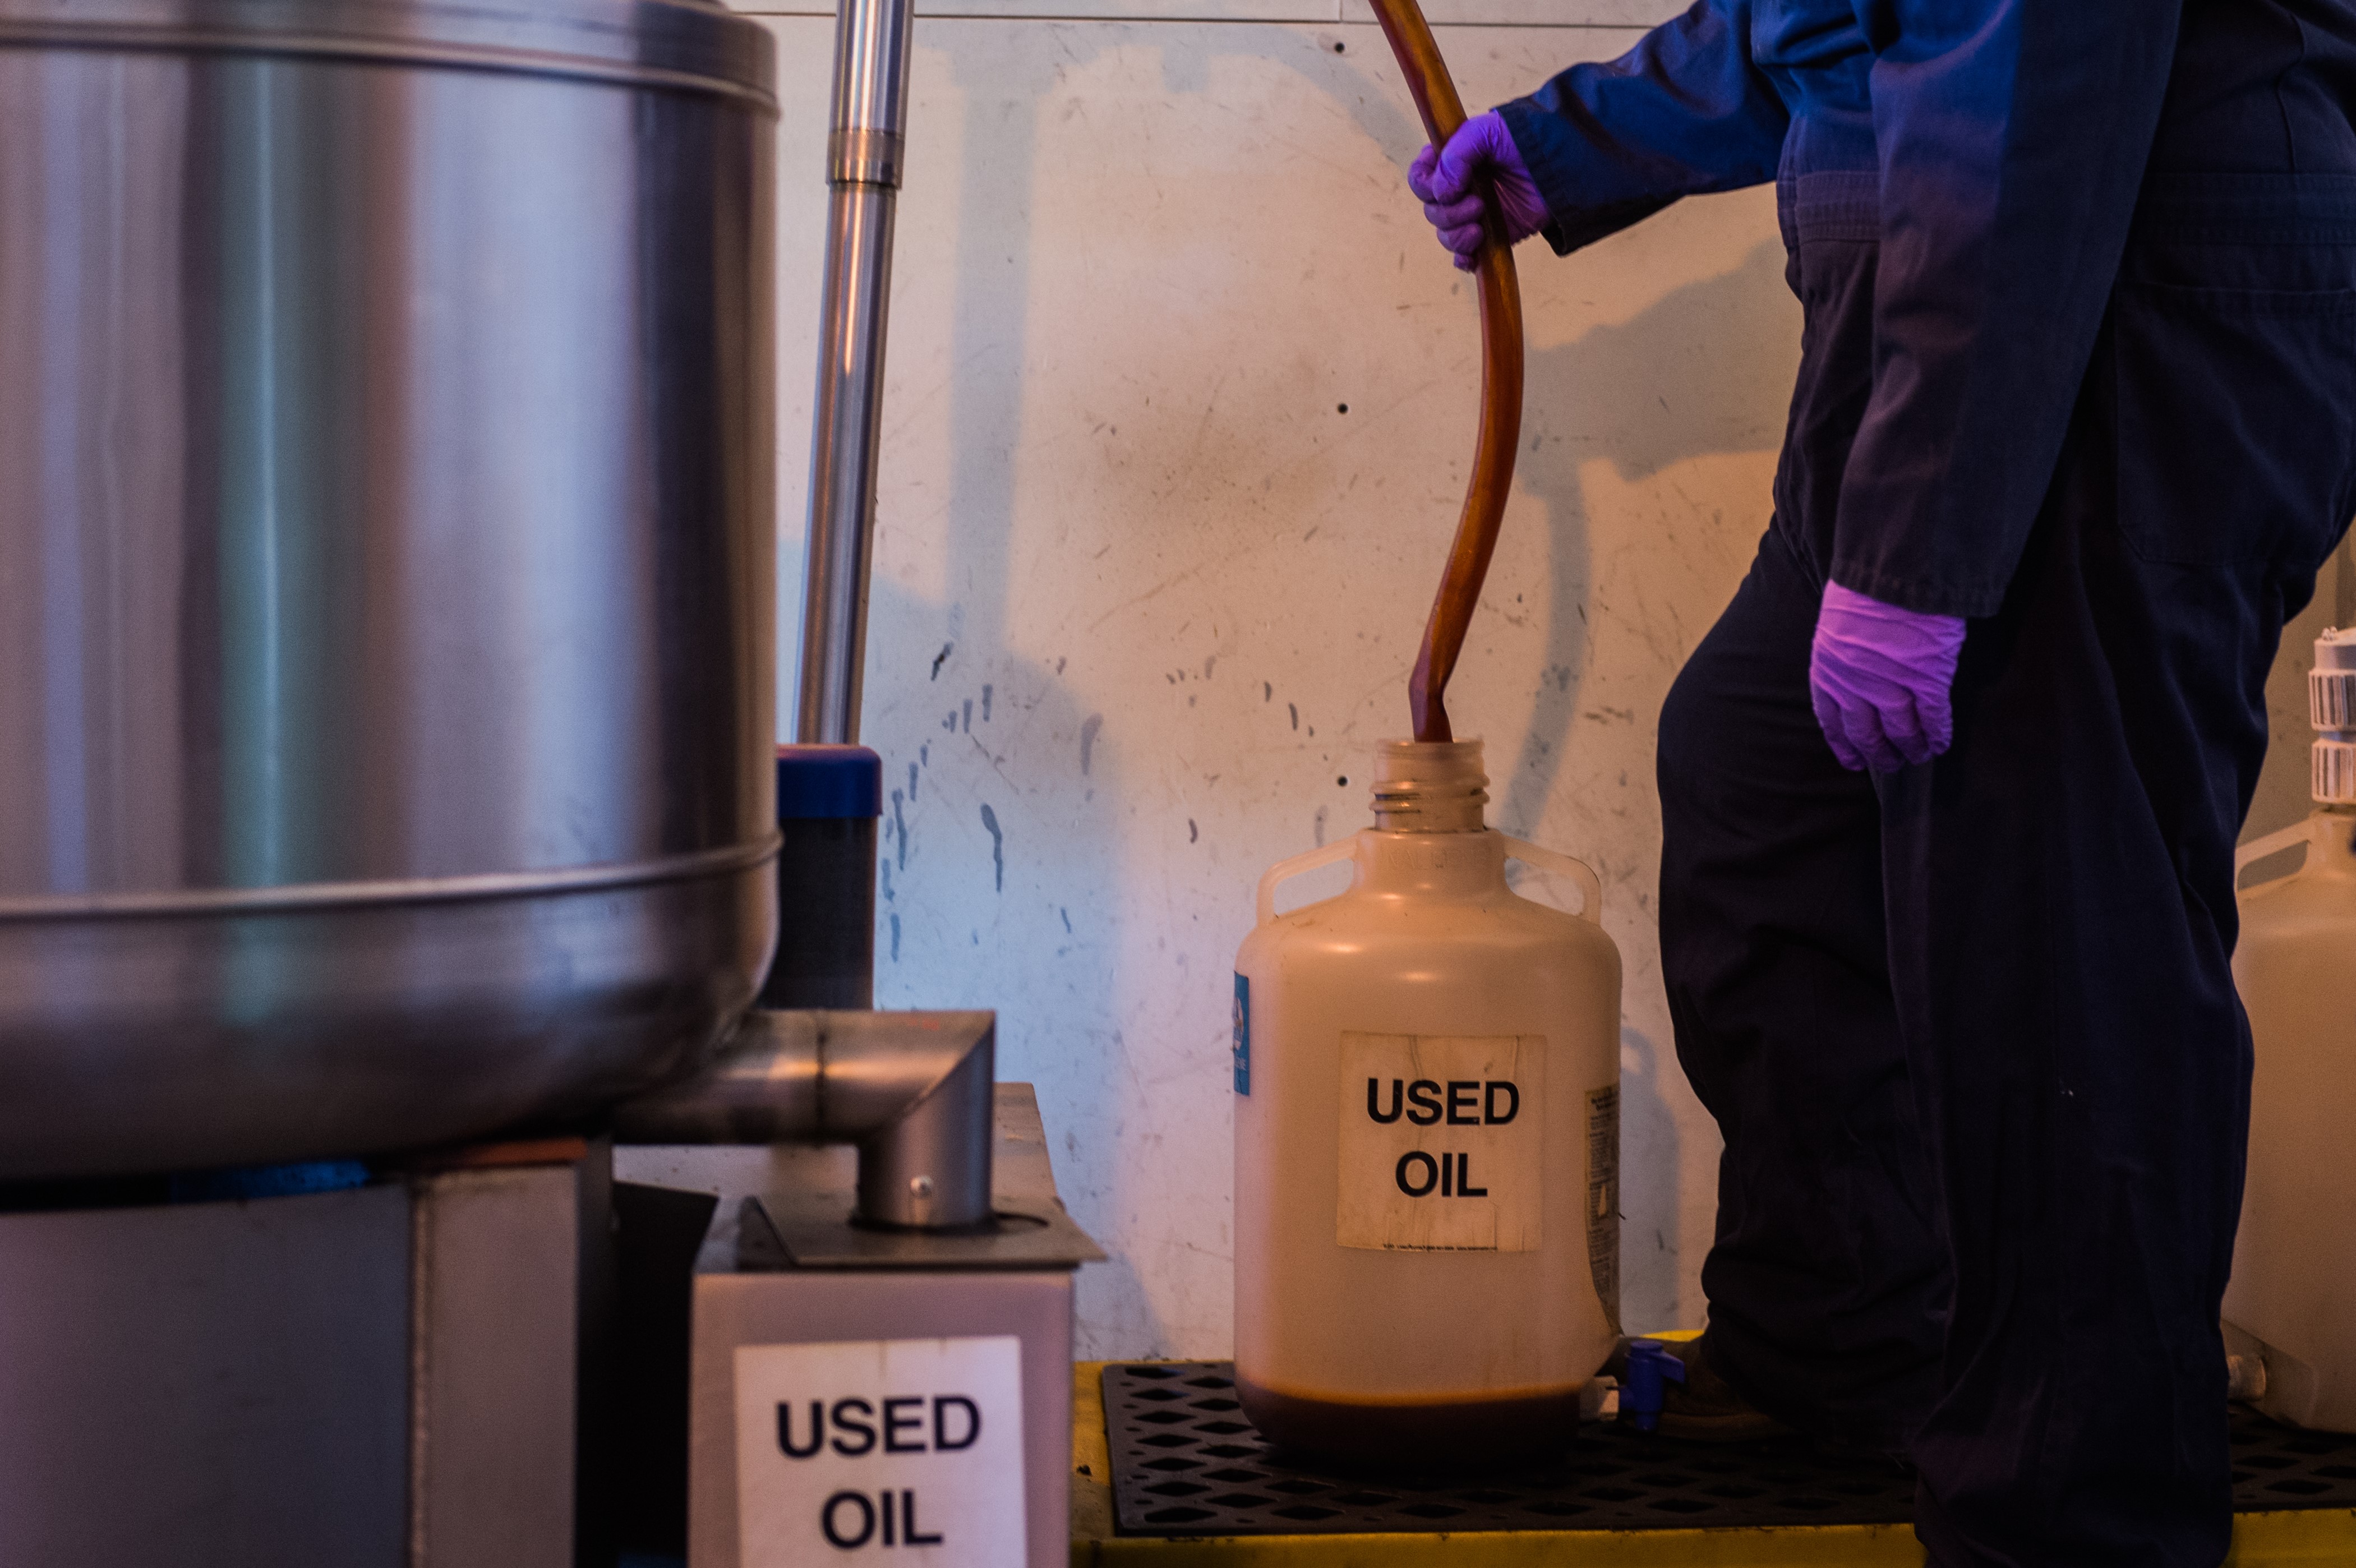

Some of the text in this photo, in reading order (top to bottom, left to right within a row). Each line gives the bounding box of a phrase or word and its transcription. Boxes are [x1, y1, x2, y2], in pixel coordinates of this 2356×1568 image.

[1367, 1078, 1520, 1126] USED
[1395, 1150, 1488, 1198] OIL
[776, 1396, 981, 1460] USED
[820, 1490, 943, 1551] OIL
